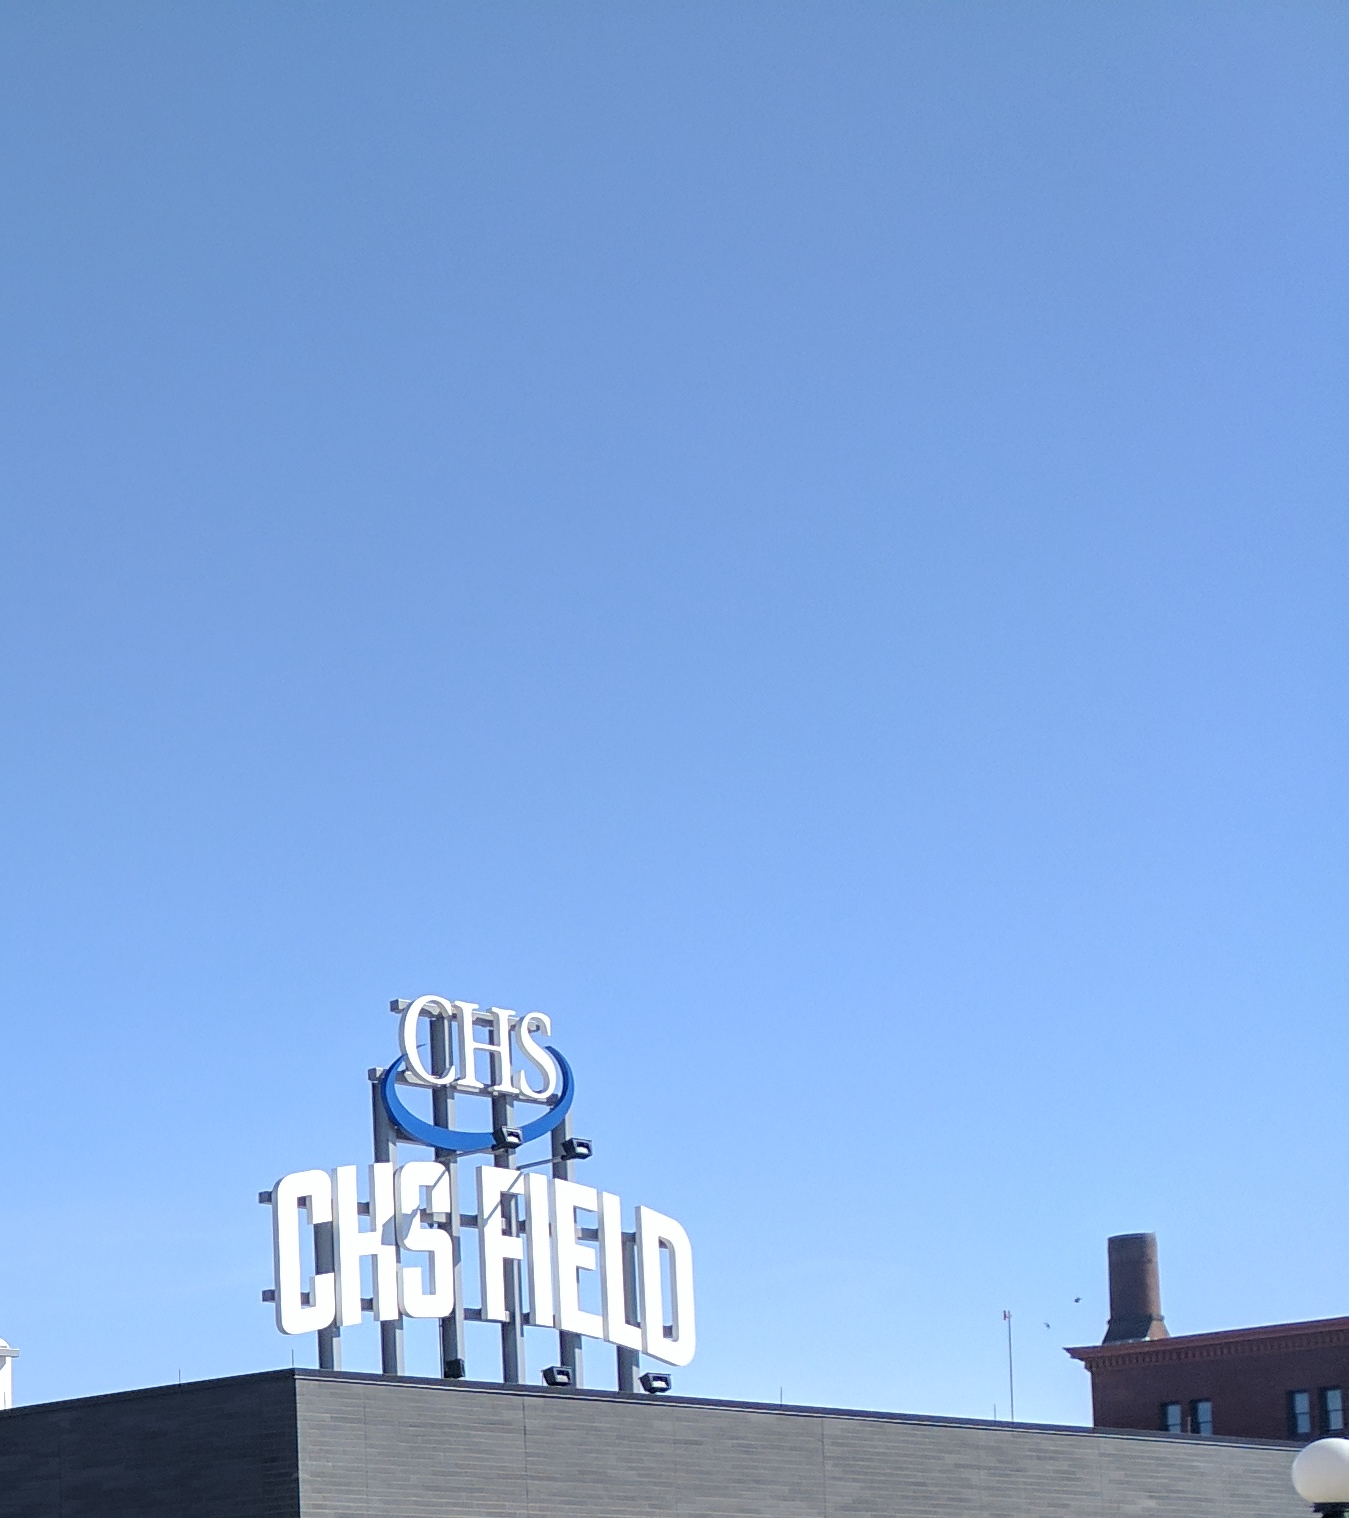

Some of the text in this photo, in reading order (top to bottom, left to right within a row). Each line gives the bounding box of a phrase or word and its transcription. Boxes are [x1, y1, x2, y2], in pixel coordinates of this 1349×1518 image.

[399, 994, 558, 1100] CHS
[272, 1161, 697, 1367] CHS FIELD
